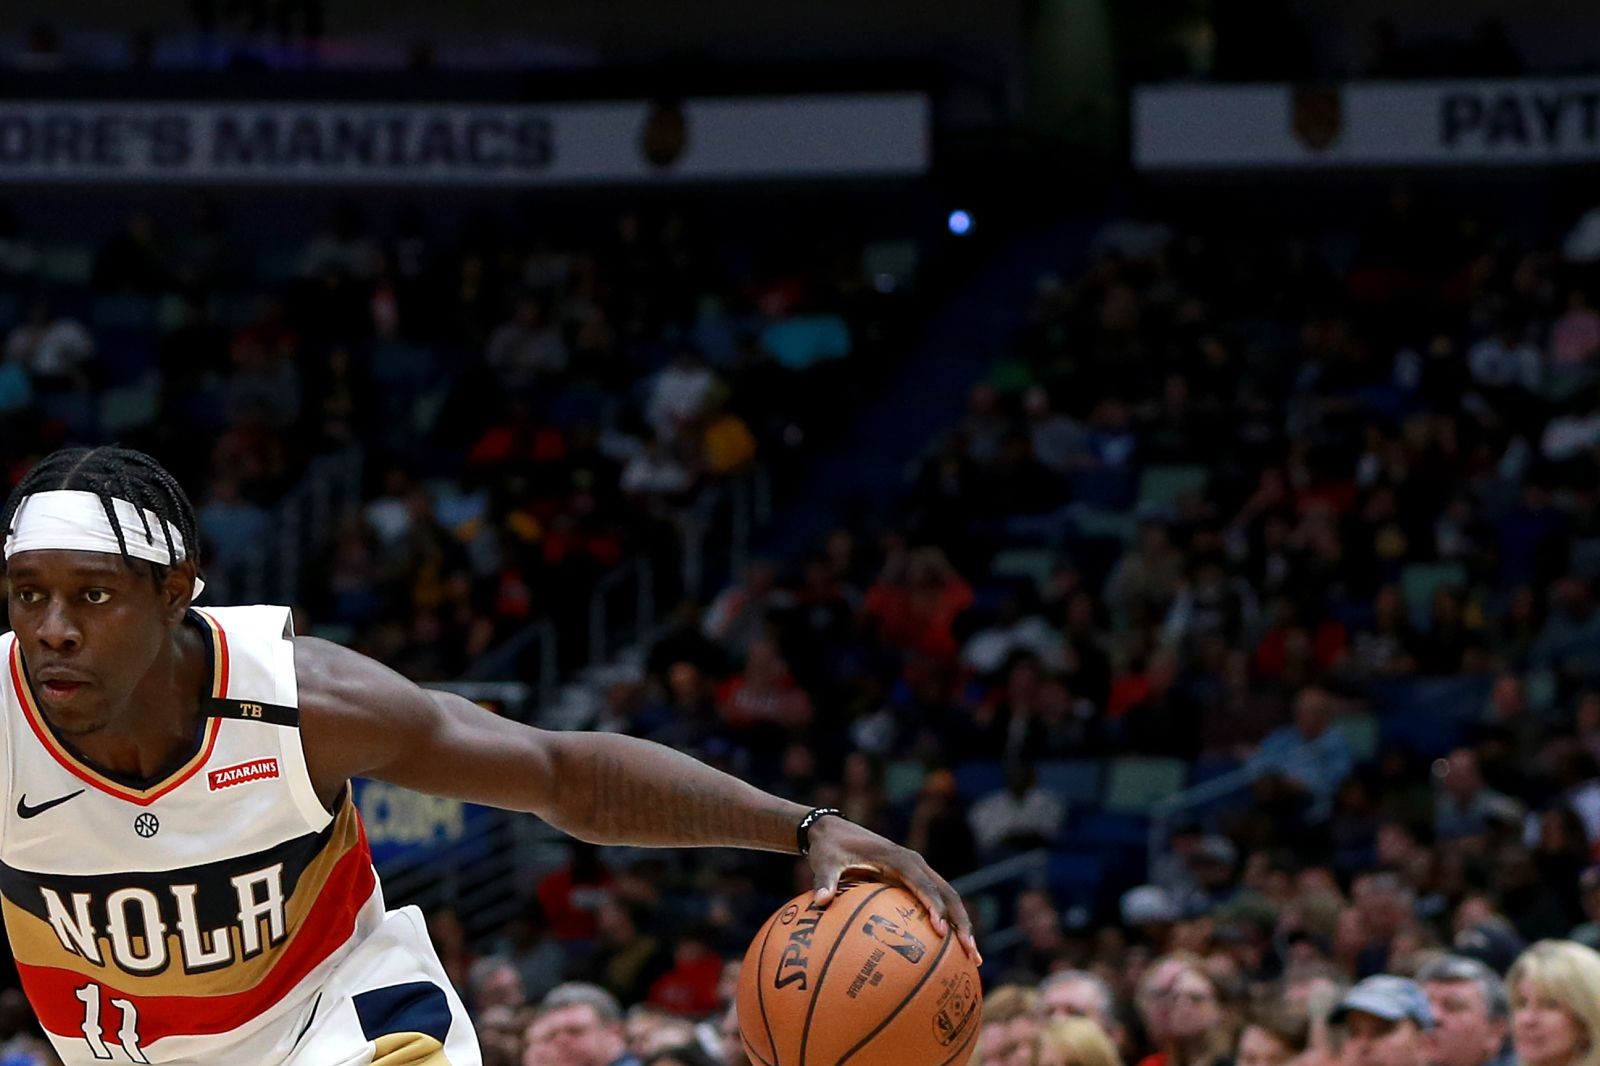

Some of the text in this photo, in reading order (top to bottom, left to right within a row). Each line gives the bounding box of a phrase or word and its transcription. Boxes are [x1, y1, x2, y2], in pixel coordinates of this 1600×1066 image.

[208, 112, 555, 170] MANIACS
[239, 703, 263, 718] TB
[39, 861, 288, 977] NOLA
[74, 982, 148, 1065] 11
